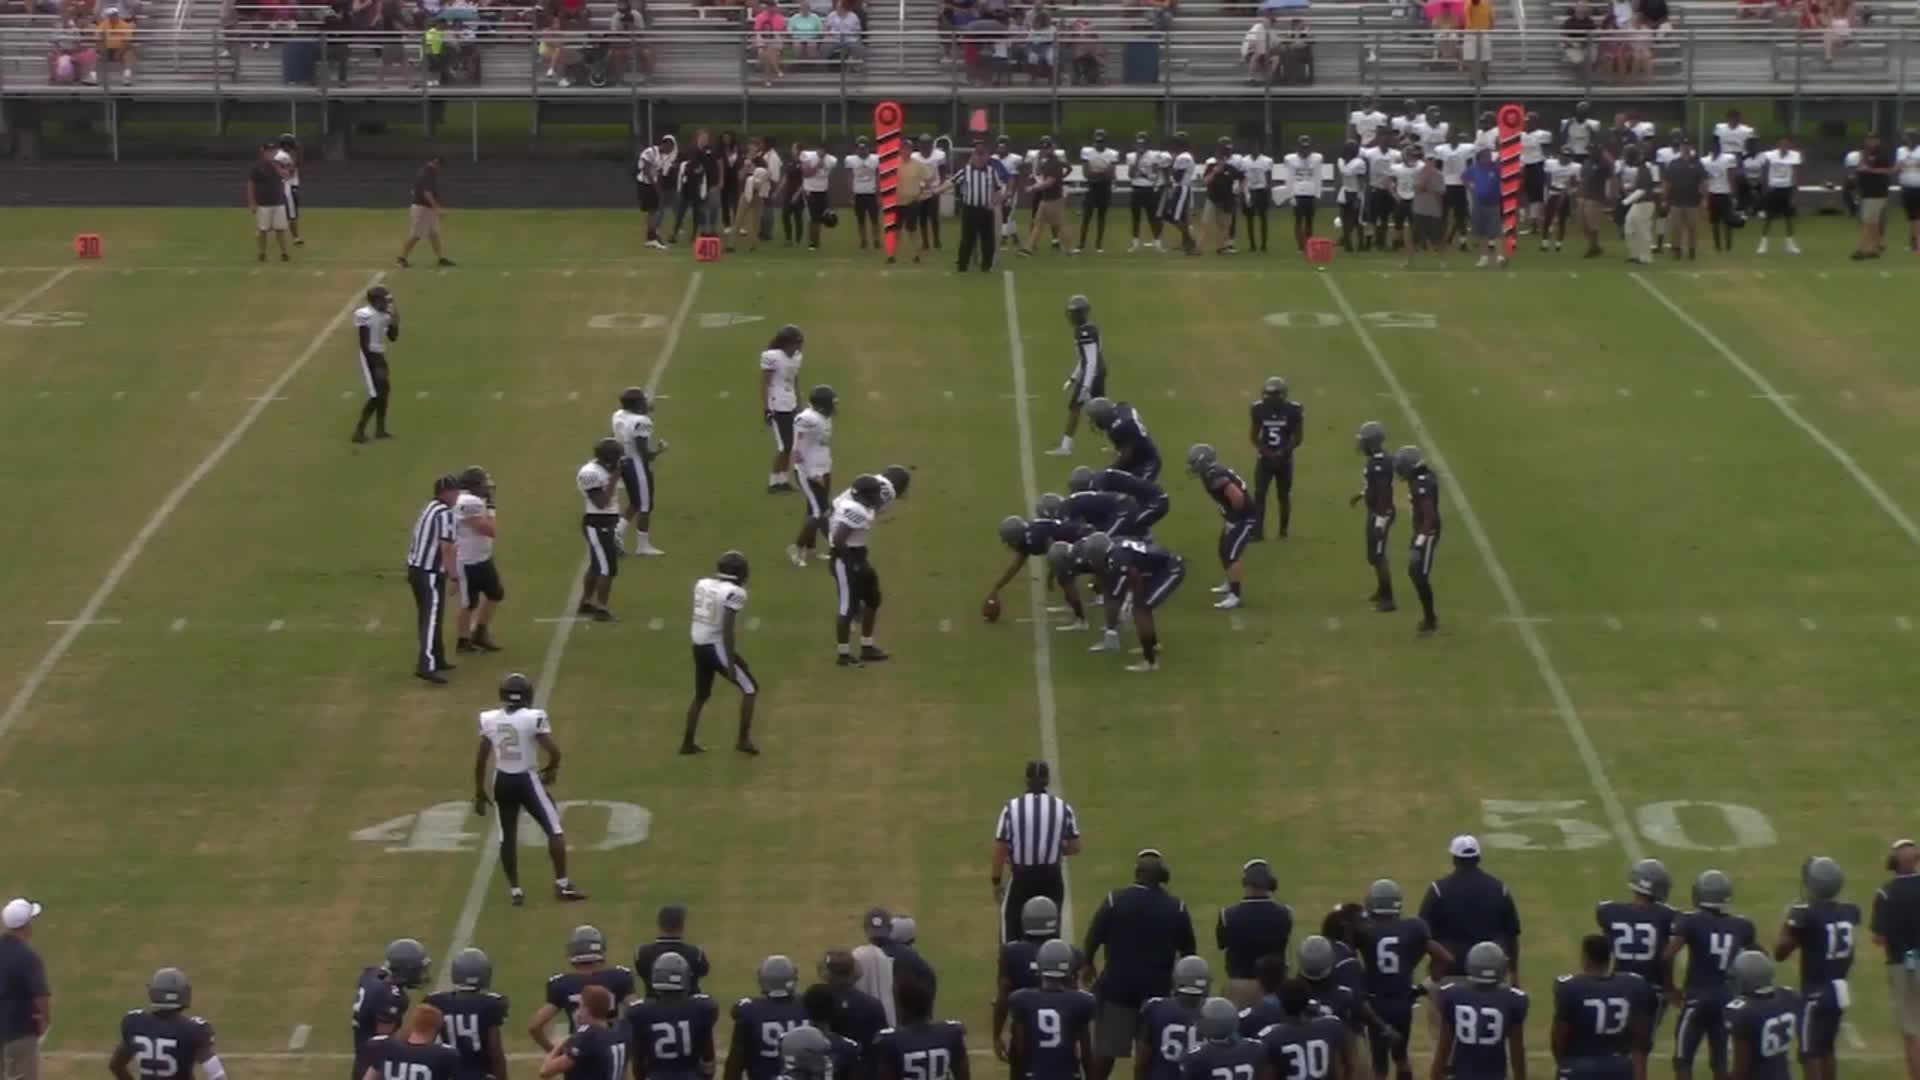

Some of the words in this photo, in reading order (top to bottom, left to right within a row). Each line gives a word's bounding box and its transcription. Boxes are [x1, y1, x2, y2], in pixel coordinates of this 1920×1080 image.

[77, 236, 99, 256] 30
[698, 239, 718, 260] 40
[1268, 426, 1281, 446] 5
[497, 722, 522, 761] 2
[349, 800, 651, 852] 40
[1480, 798, 1777, 851] 50
[1376, 936, 1400, 974] 6
[1612, 922, 1658, 960] 23
[1710, 932, 1734, 971] 4
[1826, 920, 1855, 961] 13
[443, 1014, 482, 1051] 14
[1037, 1007, 1062, 1049] 9
[1455, 1004, 1504, 1045] 83
[1583, 996, 1630, 1035] 73
[1761, 1012, 1797, 1057] 63
[133, 1035, 178, 1077] 25
[651, 1019, 692, 1059] 21
[610, 1042, 626, 1079] 11
[903, 1047, 951, 1080] 50
[1282, 1038, 1329, 1080] 30
